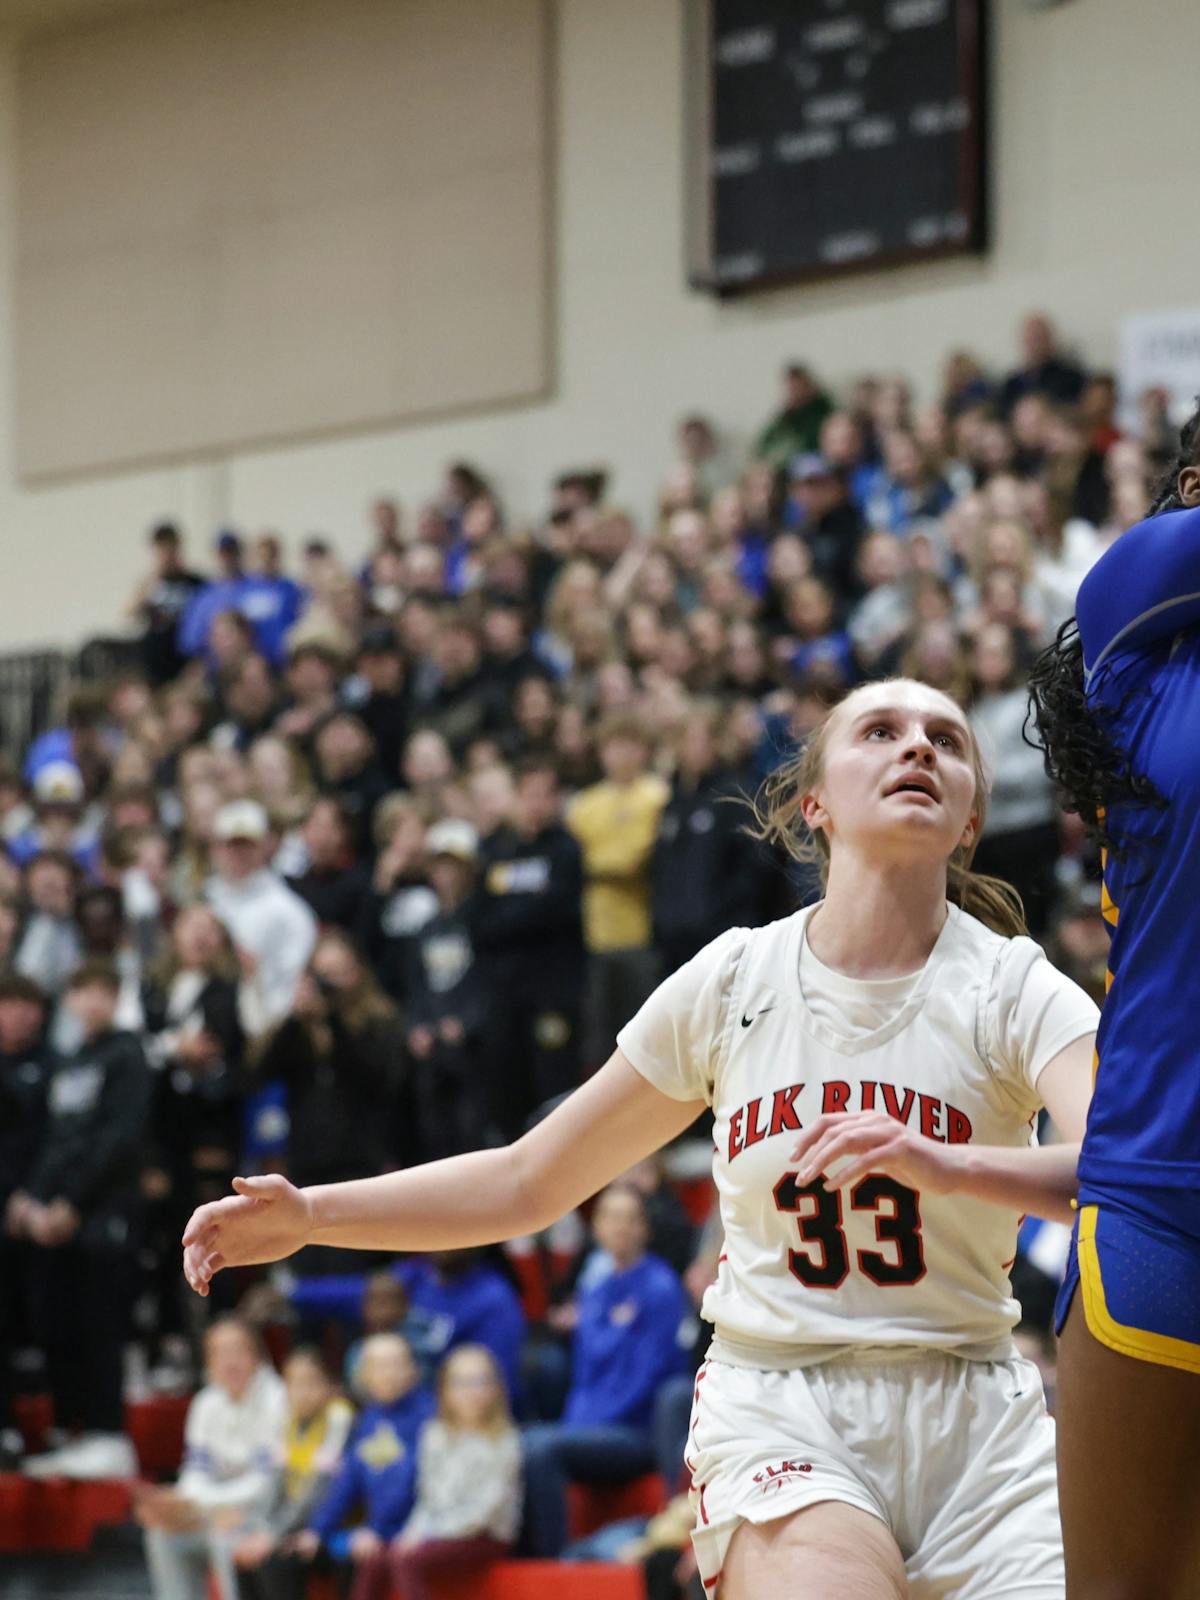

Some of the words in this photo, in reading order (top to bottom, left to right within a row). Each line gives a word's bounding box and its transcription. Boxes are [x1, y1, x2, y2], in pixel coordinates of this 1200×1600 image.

[728, 1083, 805, 1164] ELK
[822, 1080, 973, 1145] RIVER
[772, 1171, 928, 1290] 33
